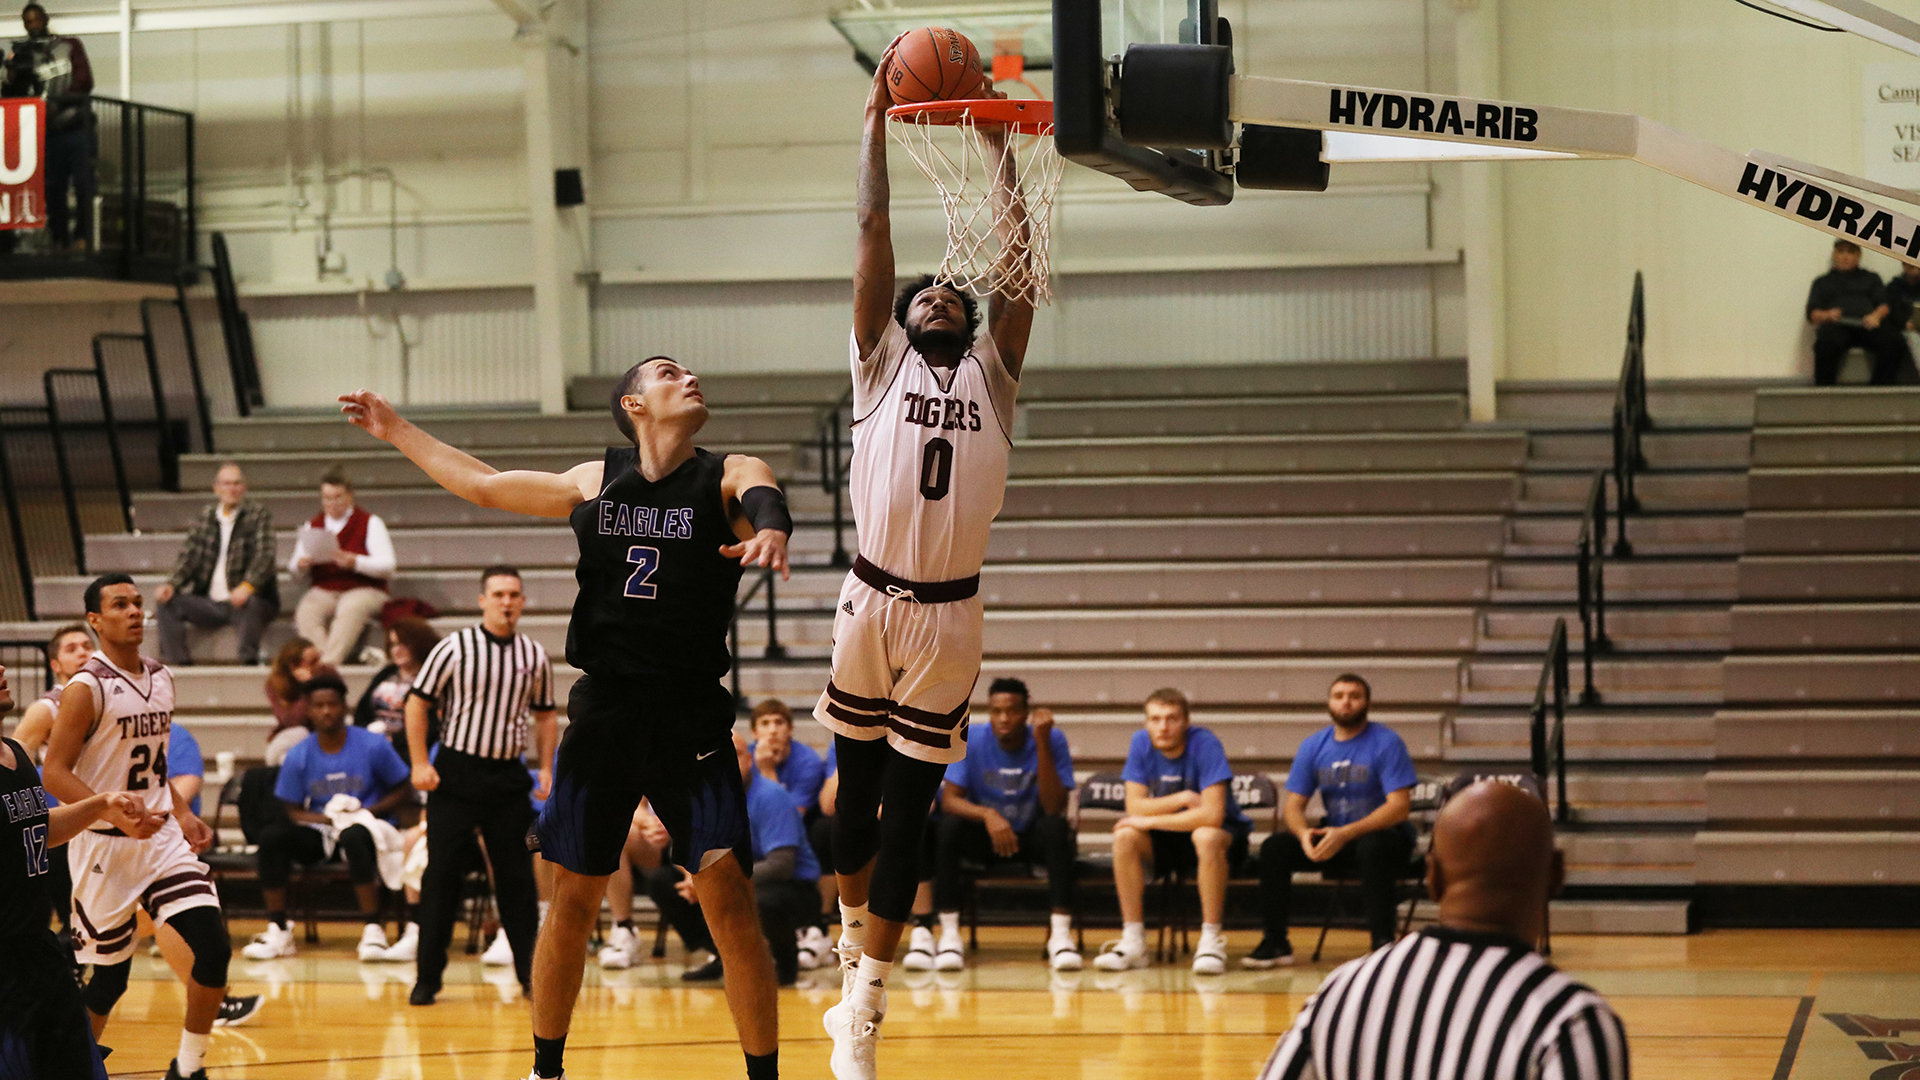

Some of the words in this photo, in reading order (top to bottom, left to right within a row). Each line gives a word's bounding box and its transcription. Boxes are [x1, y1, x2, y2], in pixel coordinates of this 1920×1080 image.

[1329, 89, 1538, 142] HYDRA-RIB
[904, 392, 982, 432] TIGERS
[919, 436, 953, 501] 0
[598, 500, 694, 539] EAGLES
[623, 545, 660, 600] 2
[127, 742, 168, 791] 24
[2, 785, 50, 824] EAGLE
[23, 823, 49, 878] 12
